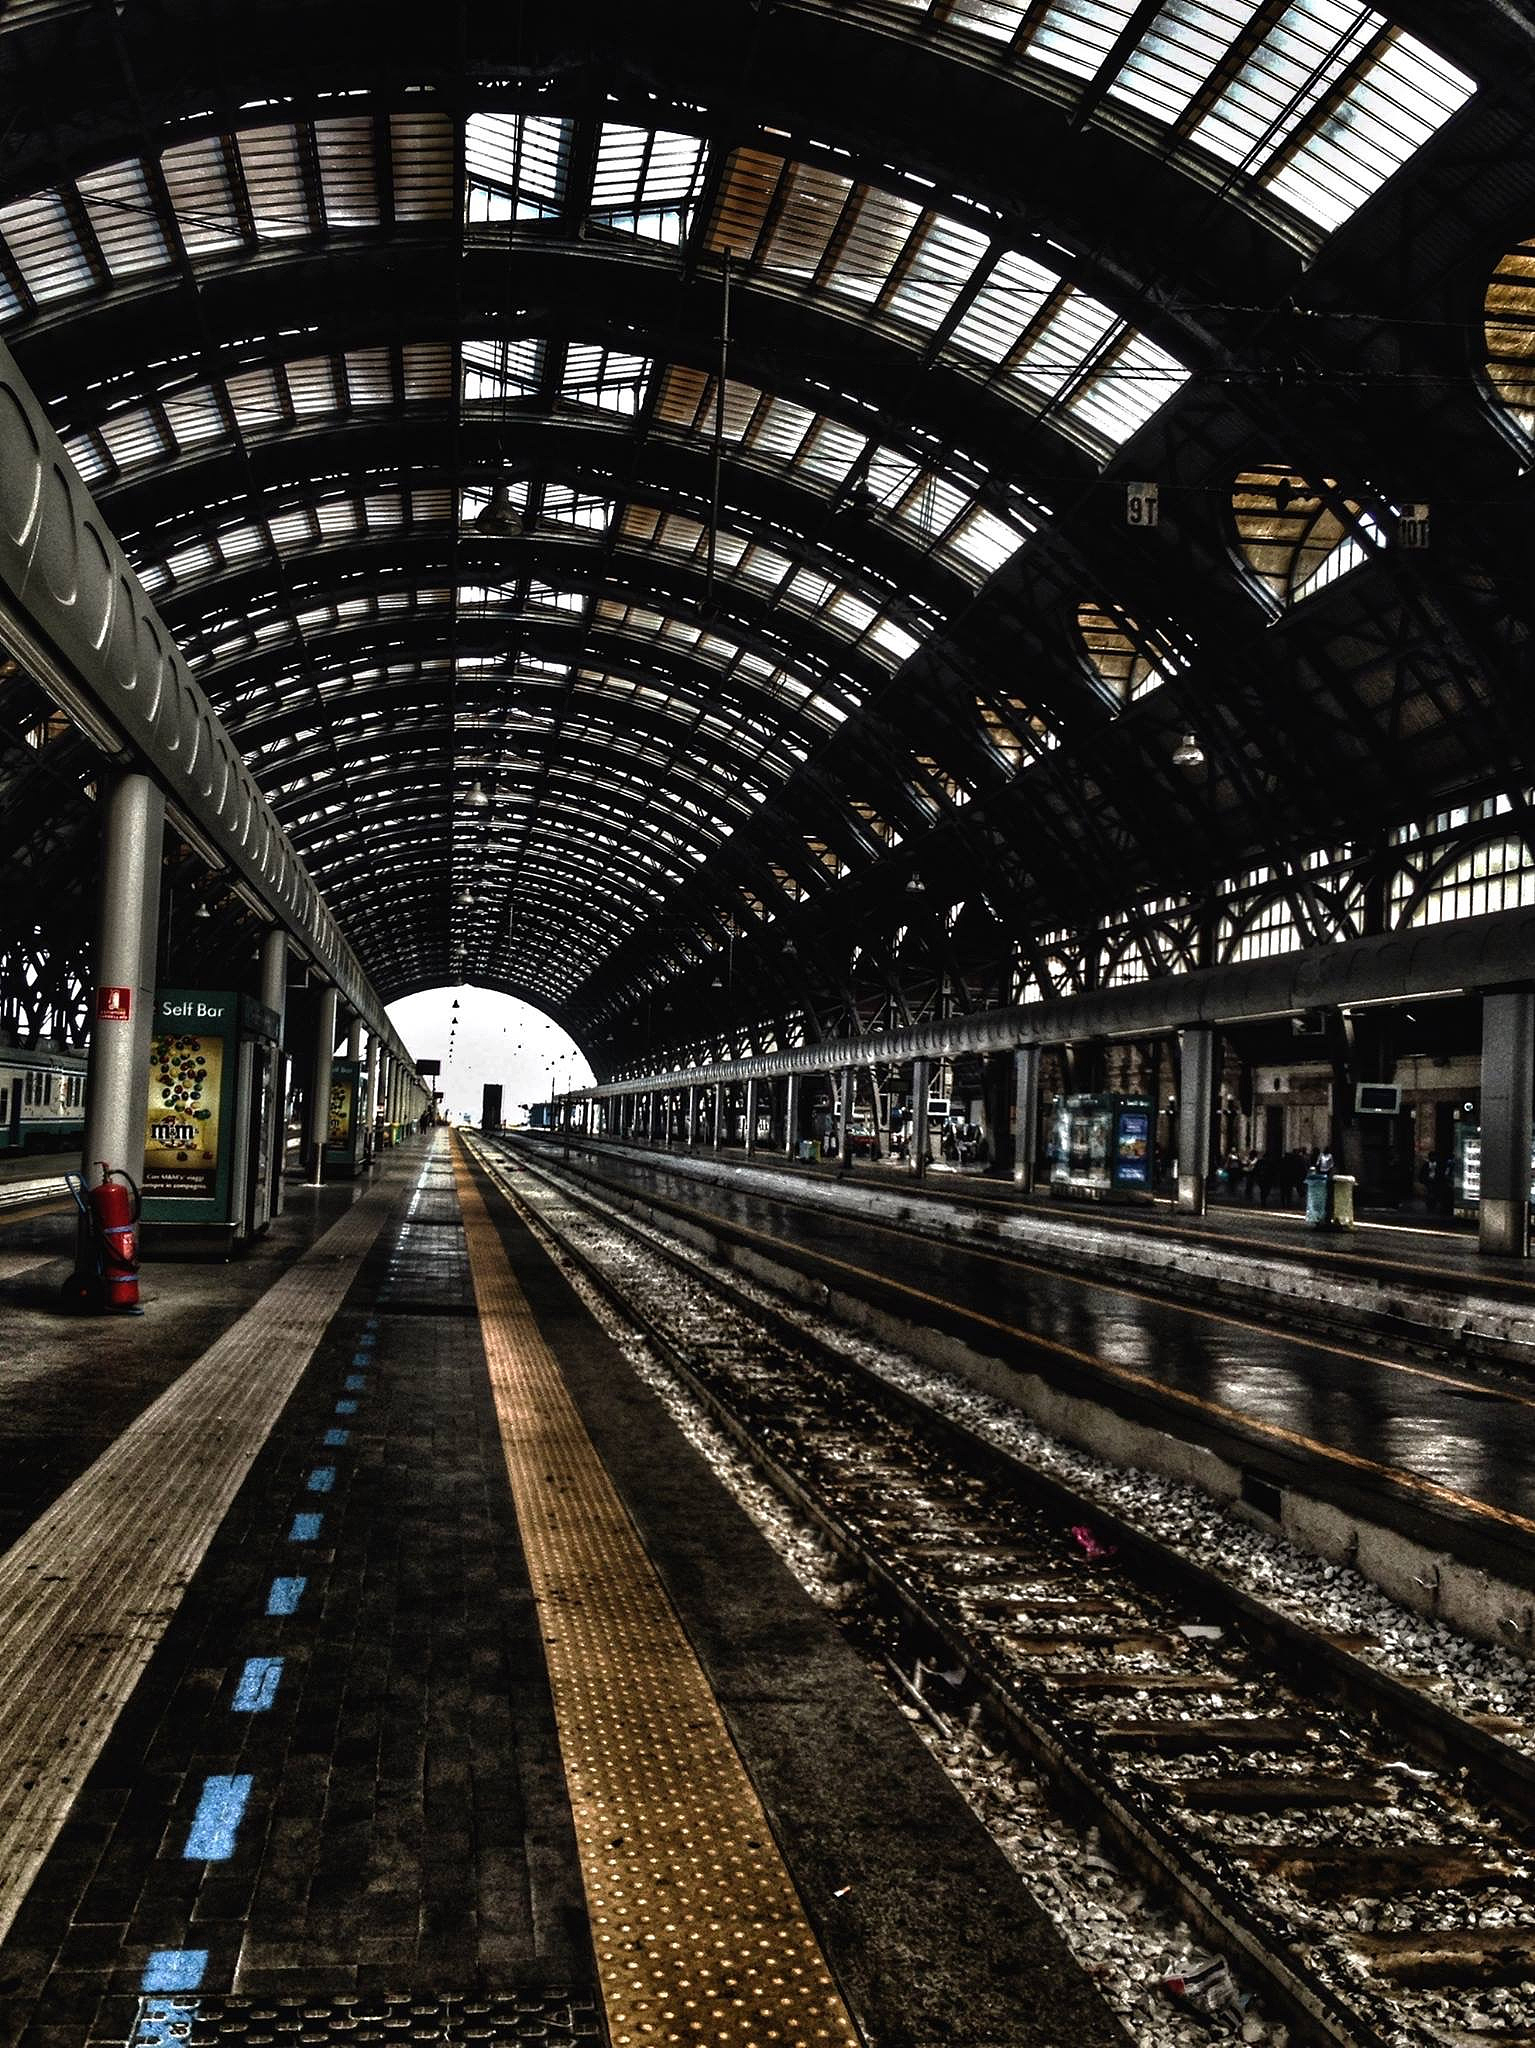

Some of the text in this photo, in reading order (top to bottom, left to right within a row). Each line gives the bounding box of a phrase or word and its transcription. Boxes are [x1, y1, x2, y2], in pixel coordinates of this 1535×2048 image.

[1129, 496, 1157, 525] 9T
[1401, 519, 1428, 546] 10T
[162, 1001, 225, 1017] Self Bar
